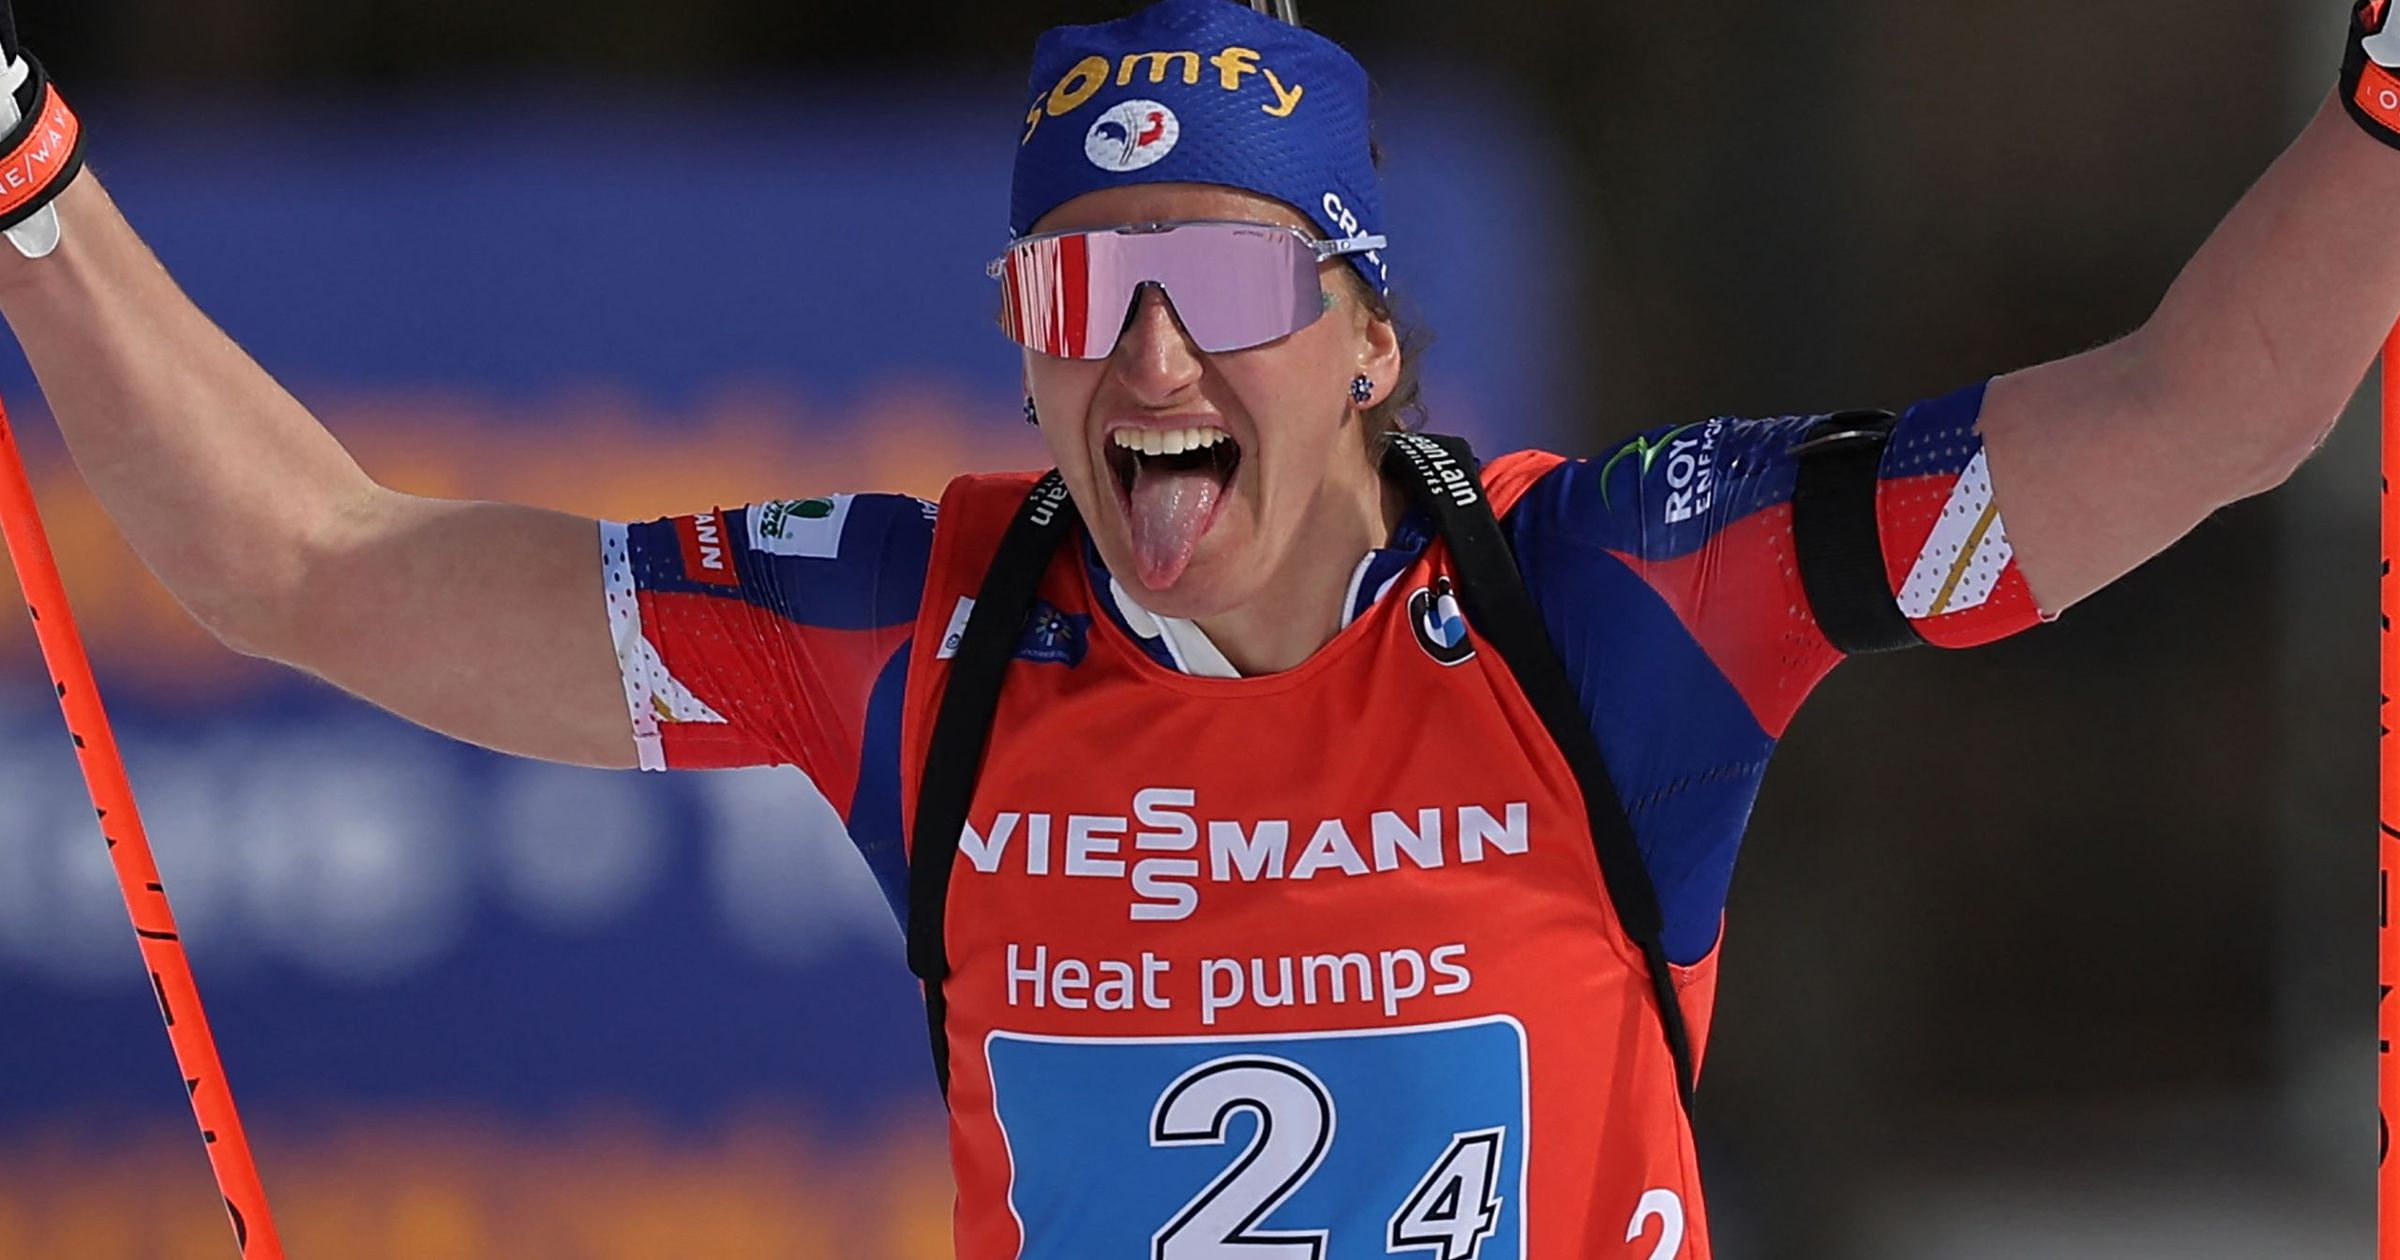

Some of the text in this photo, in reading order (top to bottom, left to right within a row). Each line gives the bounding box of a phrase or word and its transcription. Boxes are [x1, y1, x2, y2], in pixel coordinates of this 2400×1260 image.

[1021, 46, 1304, 146] somfy
[1030, 480, 1068, 526] ain
[1665, 439, 1698, 524] ROY
[959, 788, 1528, 921] VIESSMANN
[1006, 943, 1471, 1024] Heat pumps
[1150, 1054, 1507, 1260] 2 4
